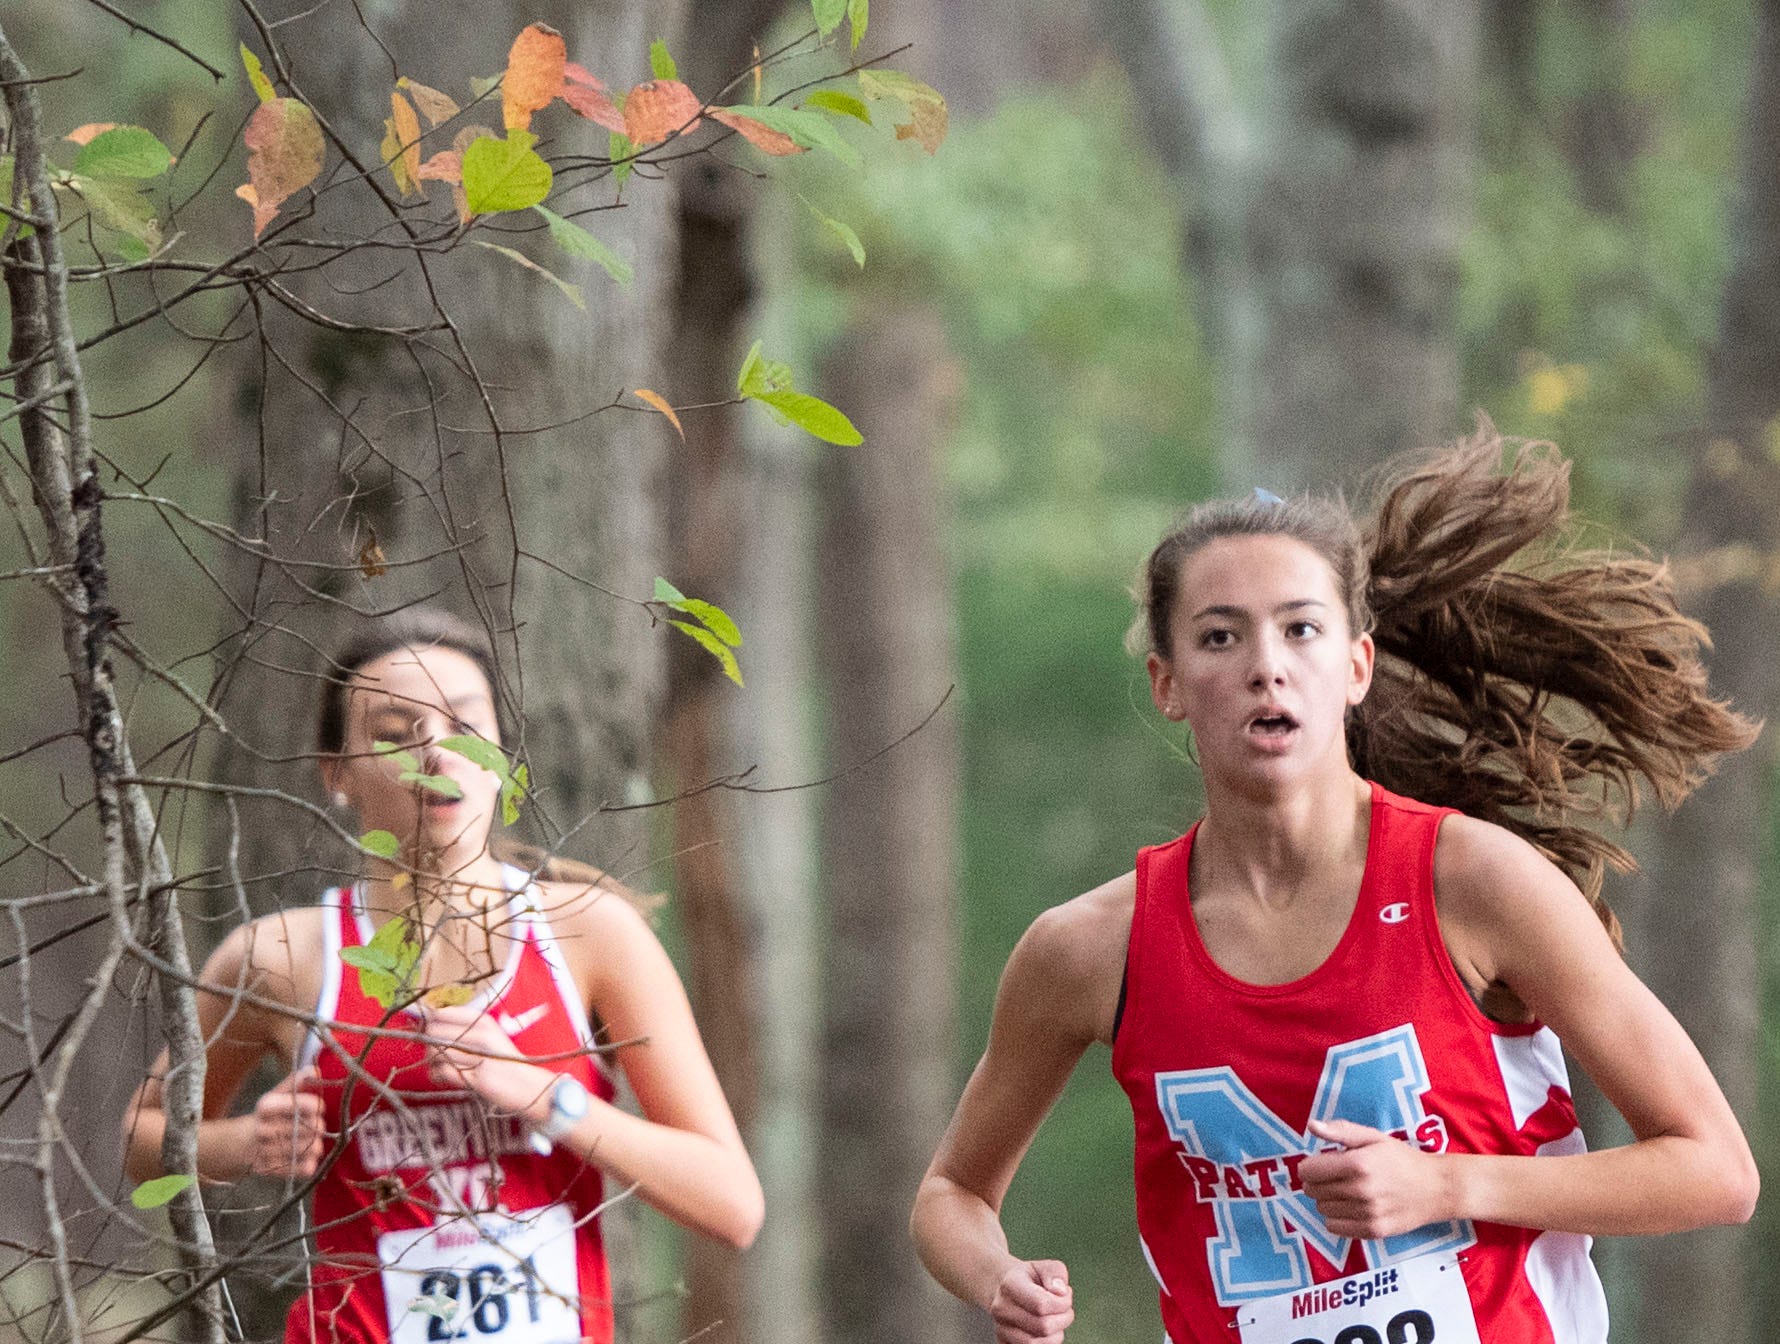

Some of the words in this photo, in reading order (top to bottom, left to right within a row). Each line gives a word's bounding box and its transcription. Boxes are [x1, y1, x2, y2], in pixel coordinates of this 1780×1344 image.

[1180, 1114, 1449, 1202] PATS
[420, 1256, 540, 1342] 261
[1291, 1268, 1399, 1320] MileSplit
